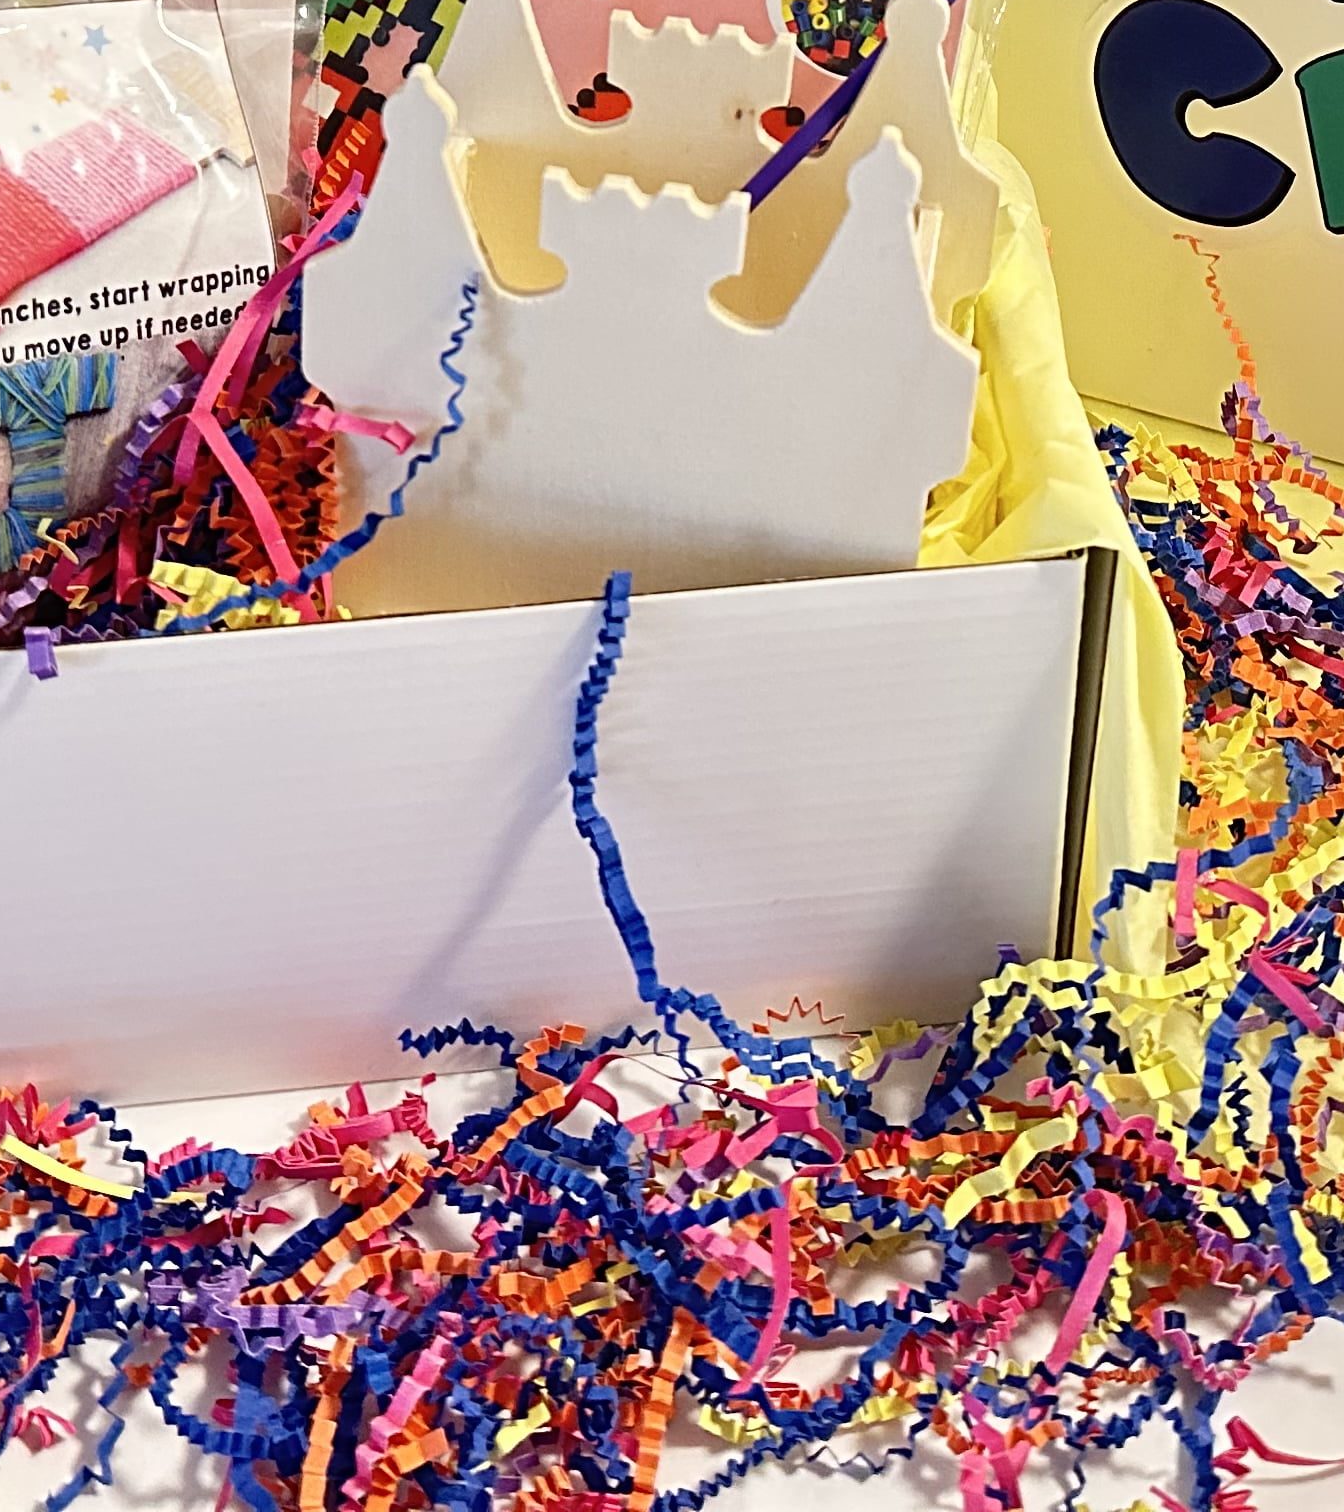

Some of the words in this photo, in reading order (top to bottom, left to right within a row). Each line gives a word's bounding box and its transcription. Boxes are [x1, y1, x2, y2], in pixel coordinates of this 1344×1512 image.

[90, 280, 150, 310] start
[25, 332, 91, 360] move
[100, 326, 129, 349] up
[136, 318, 154, 340] if
